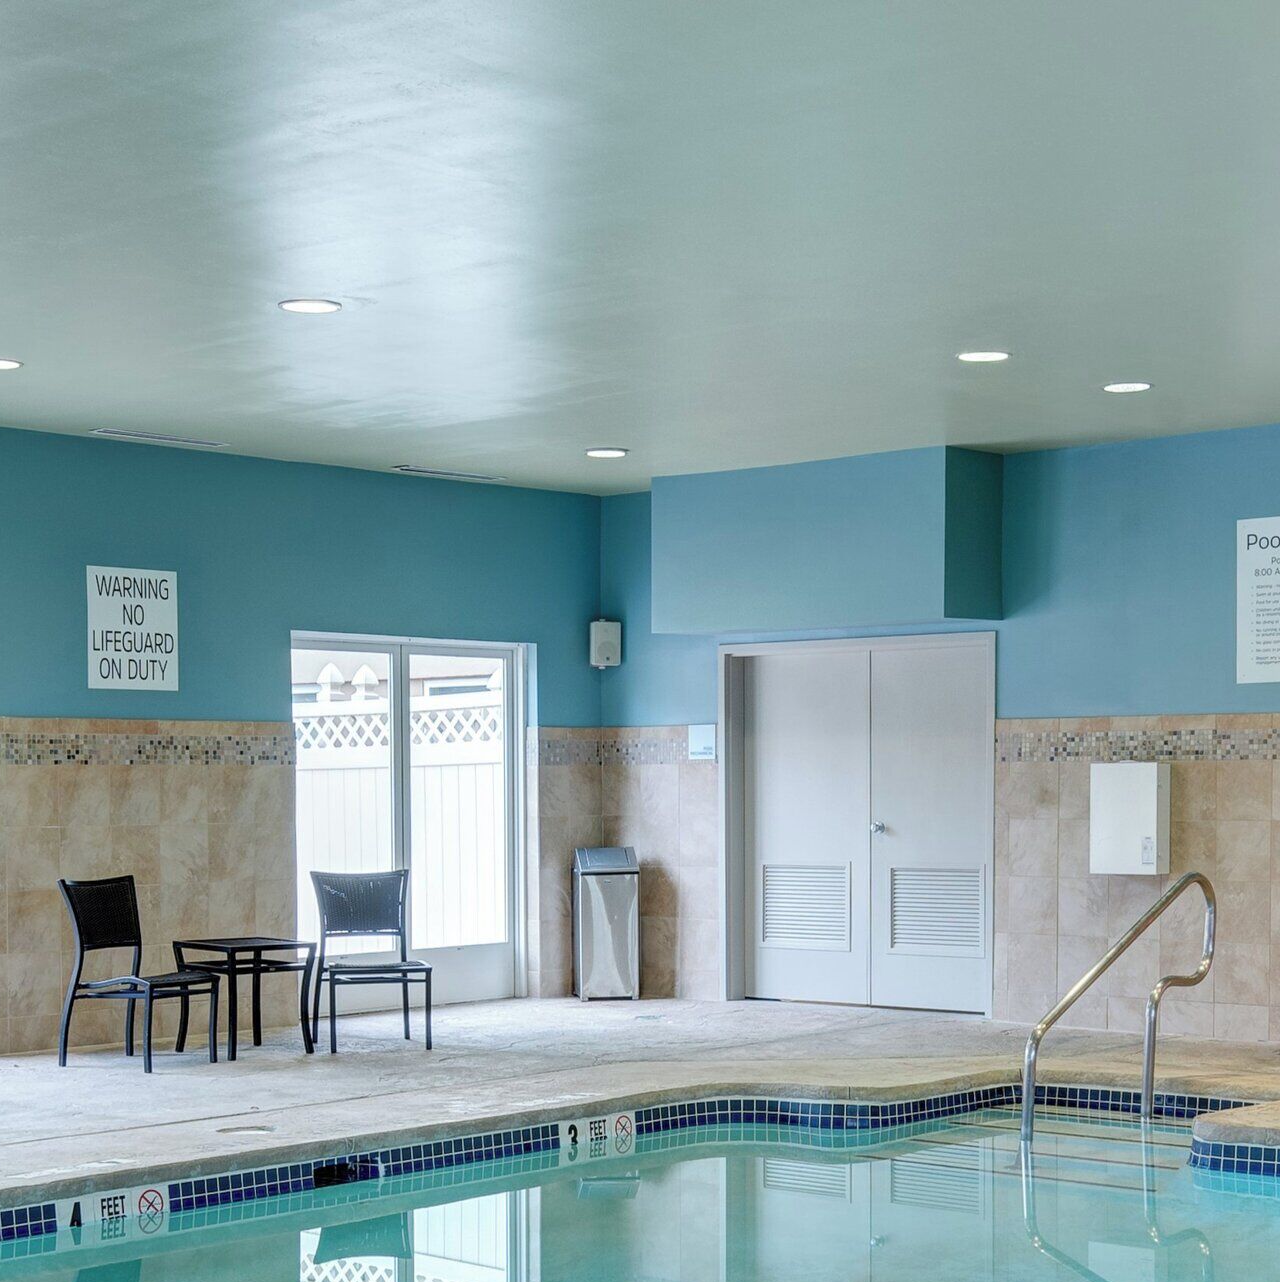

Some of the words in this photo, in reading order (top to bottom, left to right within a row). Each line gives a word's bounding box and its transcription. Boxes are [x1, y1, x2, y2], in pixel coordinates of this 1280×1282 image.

[1255, 568, 1272, 577] 8:00
[95, 575, 169, 600] WARNING
[123, 604, 144, 625] NO
[93, 630, 174, 654] LIFEGUARD
[100, 658, 121, 679] ON
[128, 659, 168, 681] DUTY
[568, 1124, 578, 1145] 3
[590, 1120, 606, 1137] FEET
[69, 1202, 83, 1227] 4
[101, 1195, 126, 1217] FEET
